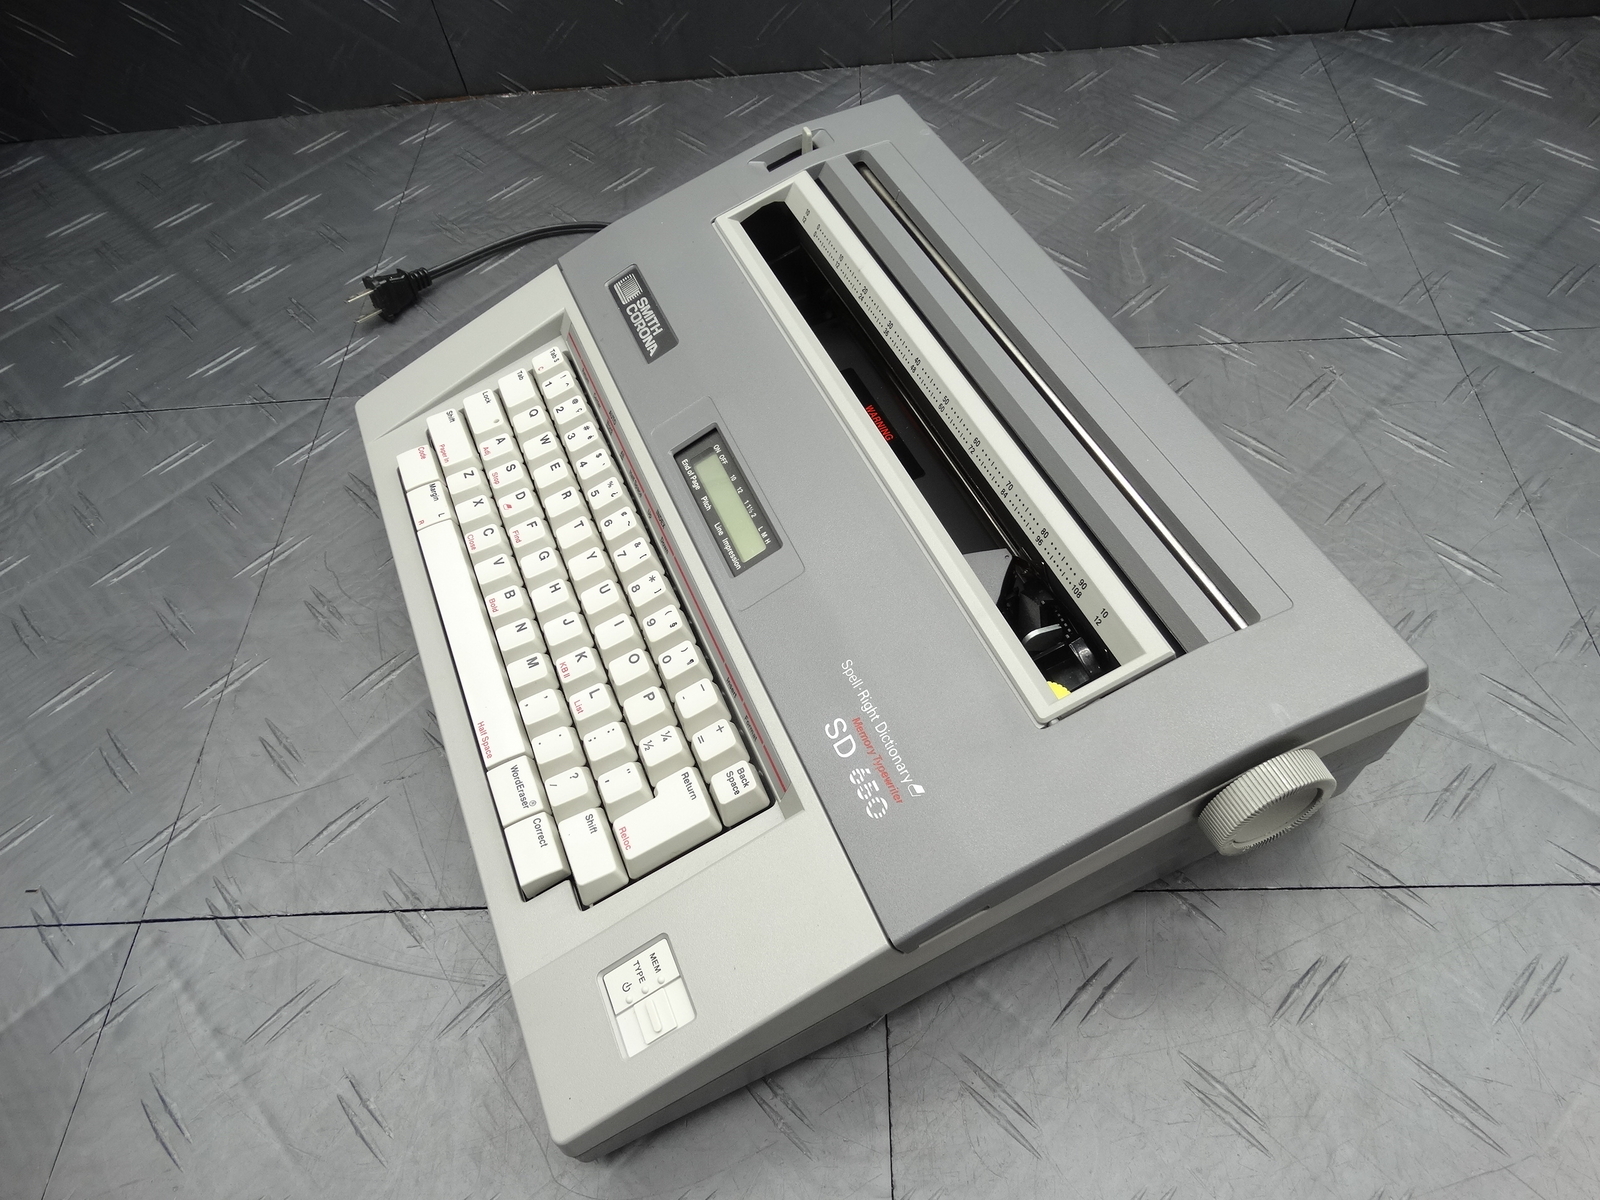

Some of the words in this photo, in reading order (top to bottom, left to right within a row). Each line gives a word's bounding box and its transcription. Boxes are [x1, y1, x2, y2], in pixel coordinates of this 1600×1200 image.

[636, 297, 663, 336] SMITH
[626, 303, 658, 357] CORONA
[482, 391, 491, 404] Lock
[446, 410, 455, 423] Shift
[528, 409, 538, 417] Q
[865, 404, 894, 441] WARNING
[540, 434, 551, 445] W
[418, 447, 426, 459] Code
[439, 444, 447, 458] Paper
[713, 444, 722, 454] ON
[719, 454, 729, 465] OFF
[862, 286, 868, 294] 20
[887, 320, 893, 330] 30
[914, 357, 921, 366] 40
[942, 396, 950, 405] 50
[972, 437, 980, 447] 60
[1006, 481, 1014, 491] 70
[1040, 527, 1050, 539] 80
[1078, 578, 1088, 590] 90
[1100, 608, 1109, 619] 10
[505, 463, 516, 472] S
[550, 462, 561, 471] E
[491, 472, 500, 485] Stop
[681, 458, 690, 471] End
[687, 469, 693, 477] of
[690, 476, 701, 491] Page
[429, 483, 439, 501] Margin
[515, 492, 526, 500] D
[561, 490, 572, 500] R
[910, 364, 916, 373] 48
[938, 404, 945, 412] 60
[968, 445, 976, 454] 72
[1000, 488, 1008, 498] 84
[1034, 535, 1043, 546] 96
[1071, 584, 1083, 599] 108
[1093, 616, 1102, 627] 12
[473, 498, 484, 507] X
[701, 496, 711, 512] Pitch
[574, 520, 584, 529] T
[714, 522, 724, 536] Line
[483, 528, 494, 536] C
[467, 534, 476, 550] Close
[538, 551, 550, 561] G
[586, 551, 597, 560] Y
[722, 538, 742, 570] Impression
[549, 582, 561, 593] H
[599, 584, 611, 594] U
[631, 584, 640, 592] 8
[504, 590, 516, 599] B
[489, 598, 499, 613] Bold
[515, 622, 528, 632] N
[647, 618, 656, 627] 9
[526, 656, 539, 668] M
[575, 651, 588, 662] K
[629, 653, 640, 664] O
[662, 655, 672, 664] 0
[559, 662, 568, 673] KB
[589, 688, 600, 699] L
[726, 677, 737, 698] Insert
[643, 692, 655, 700] P
[573, 700, 584, 714] List
[477, 721, 486, 736] Half
[716, 724, 725, 733] +
[744, 715, 758, 742] Format
[697, 735, 705, 744] =
[481, 735, 493, 759] Space
[874, 721, 913, 784] Dictionary
[852, 716, 877, 756] Memory
[872, 755, 903, 804] Typewriter
[825, 718, 856, 758] SD
[850, 768, 888, 819] 650
[726, 770, 740, 796] Space
[736, 767, 749, 788] Back
[681, 771, 697, 800] Return
[585, 814, 598, 835] Shift
[532, 817, 548, 848] Correct
[618, 826, 632, 850] Reloc
[649, 952, 662, 974] MEM
[633, 960, 646, 984] TYPE
